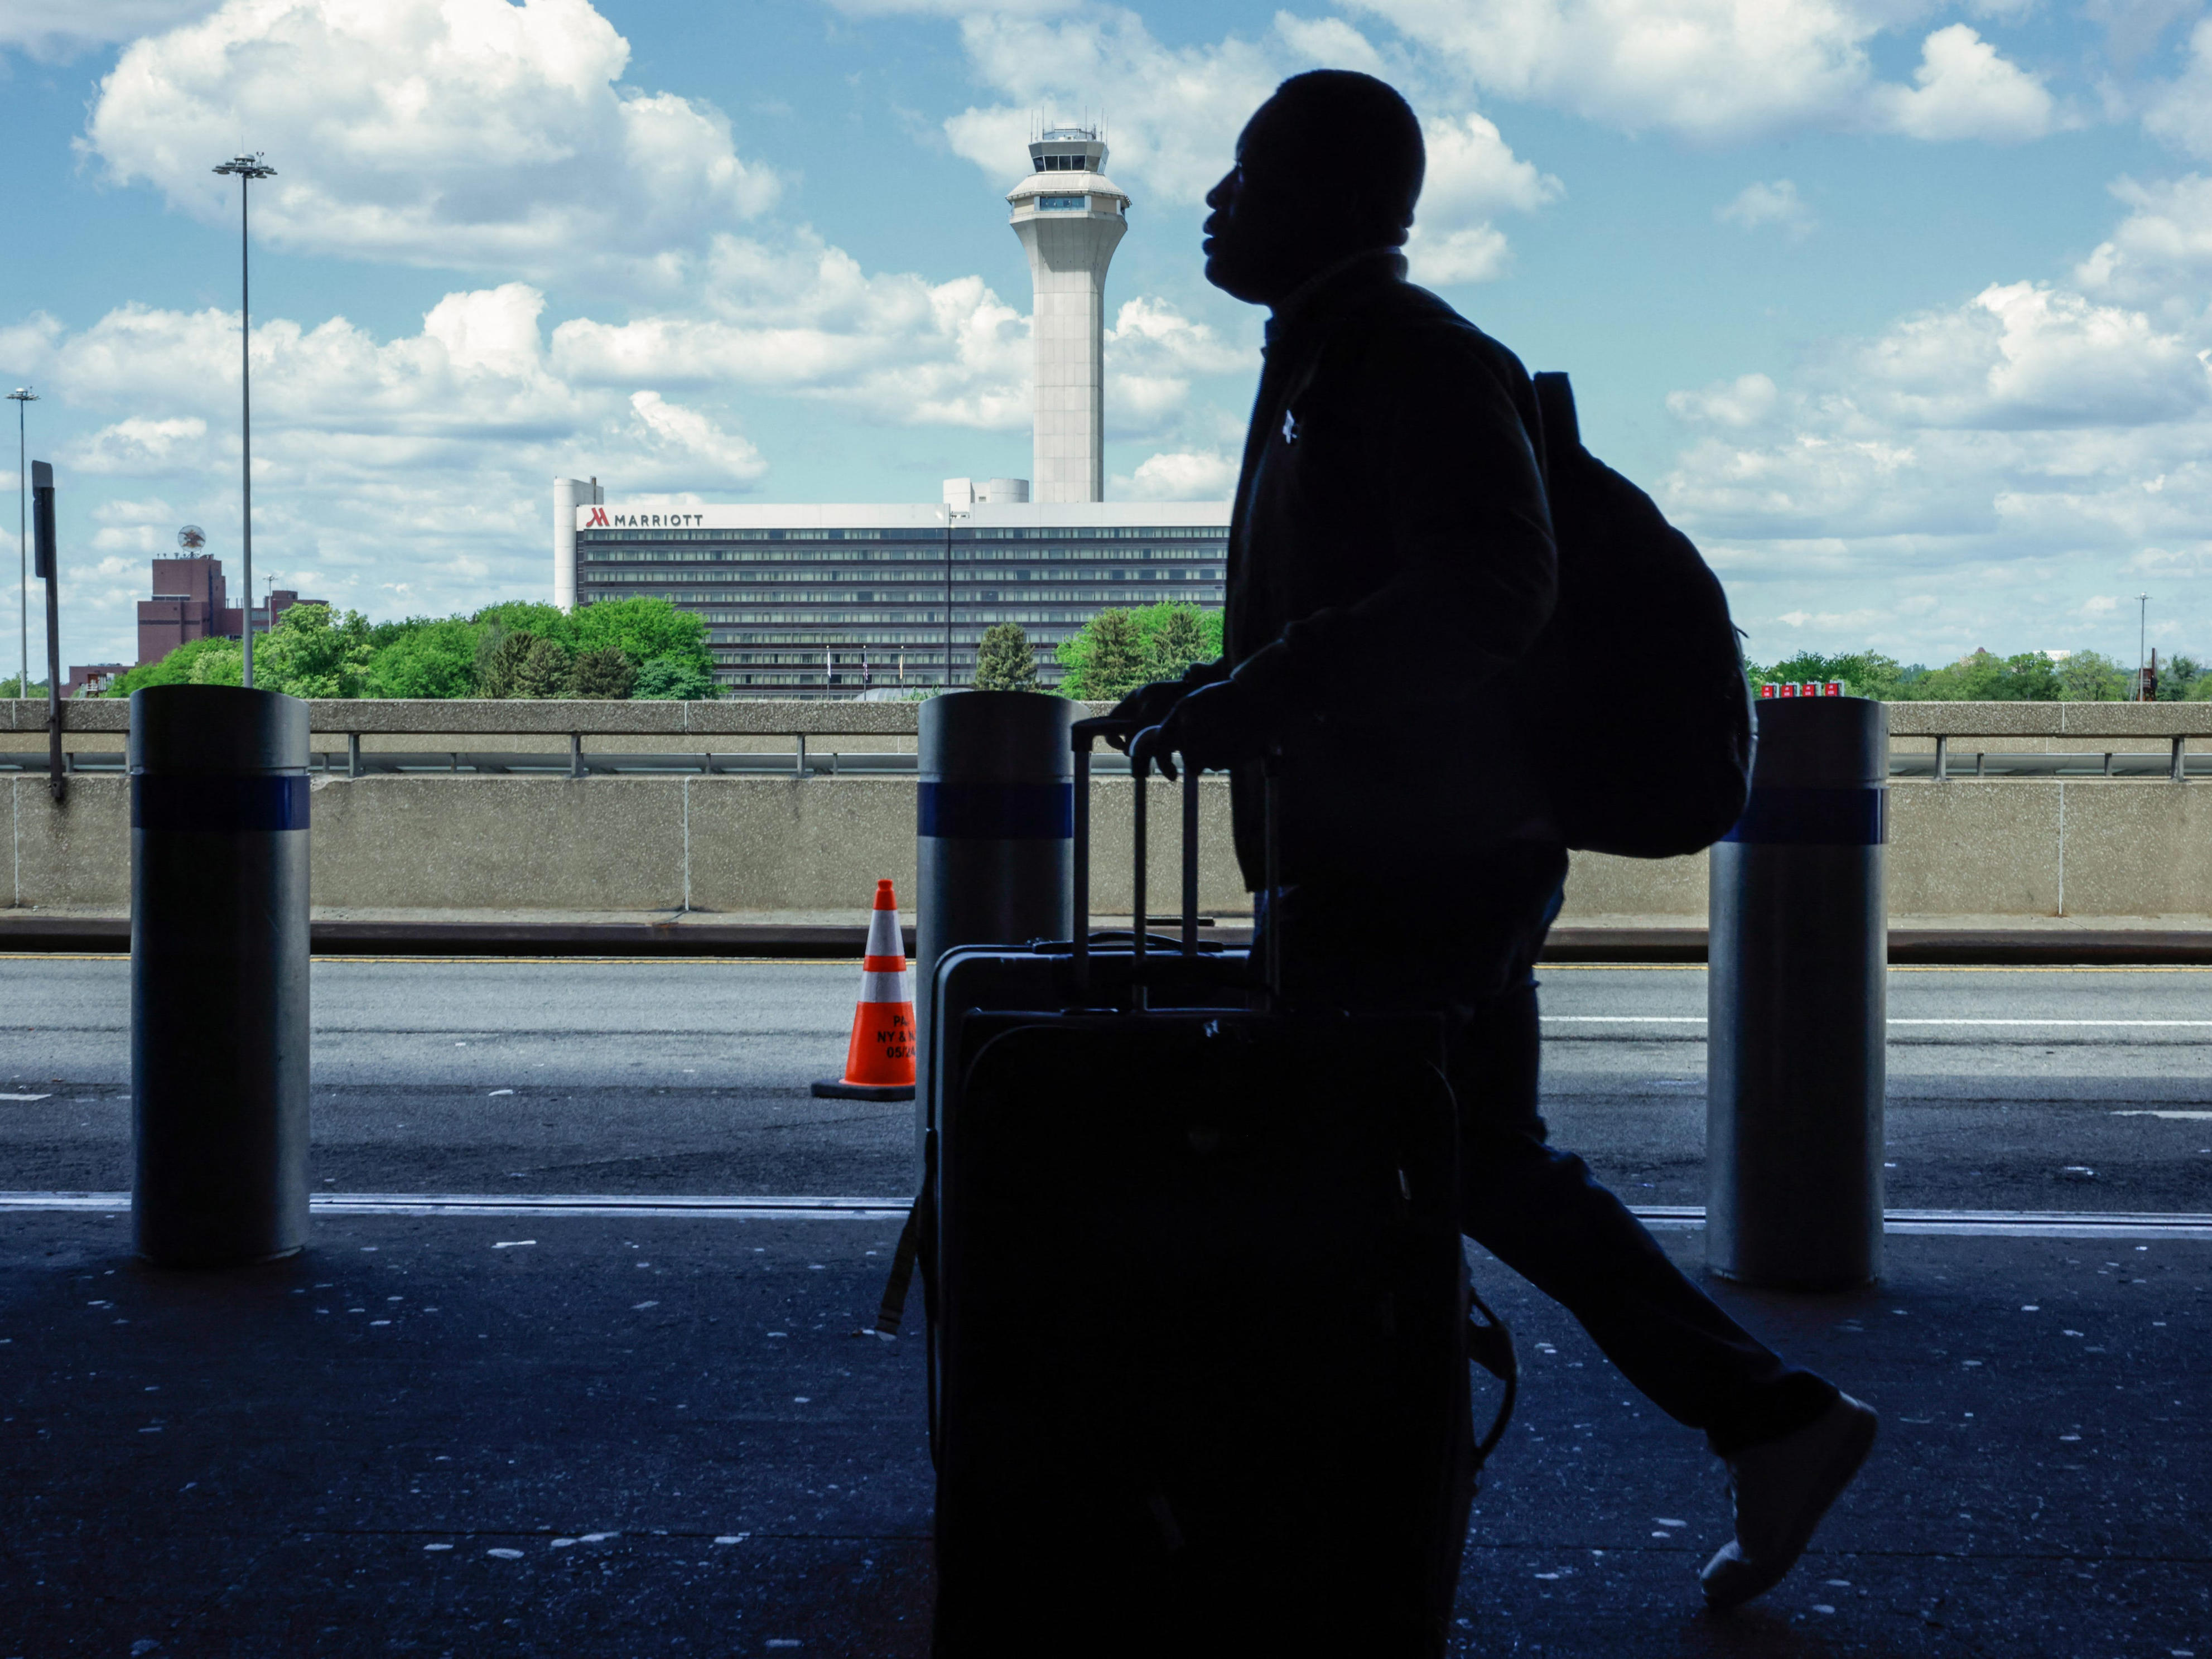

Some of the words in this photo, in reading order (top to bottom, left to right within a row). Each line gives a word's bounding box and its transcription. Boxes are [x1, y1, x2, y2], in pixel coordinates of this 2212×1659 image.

[615, 515, 702, 526] MARRIOTT
[878, 1031, 895, 1043] NY
[900, 1031, 907, 1042] &
